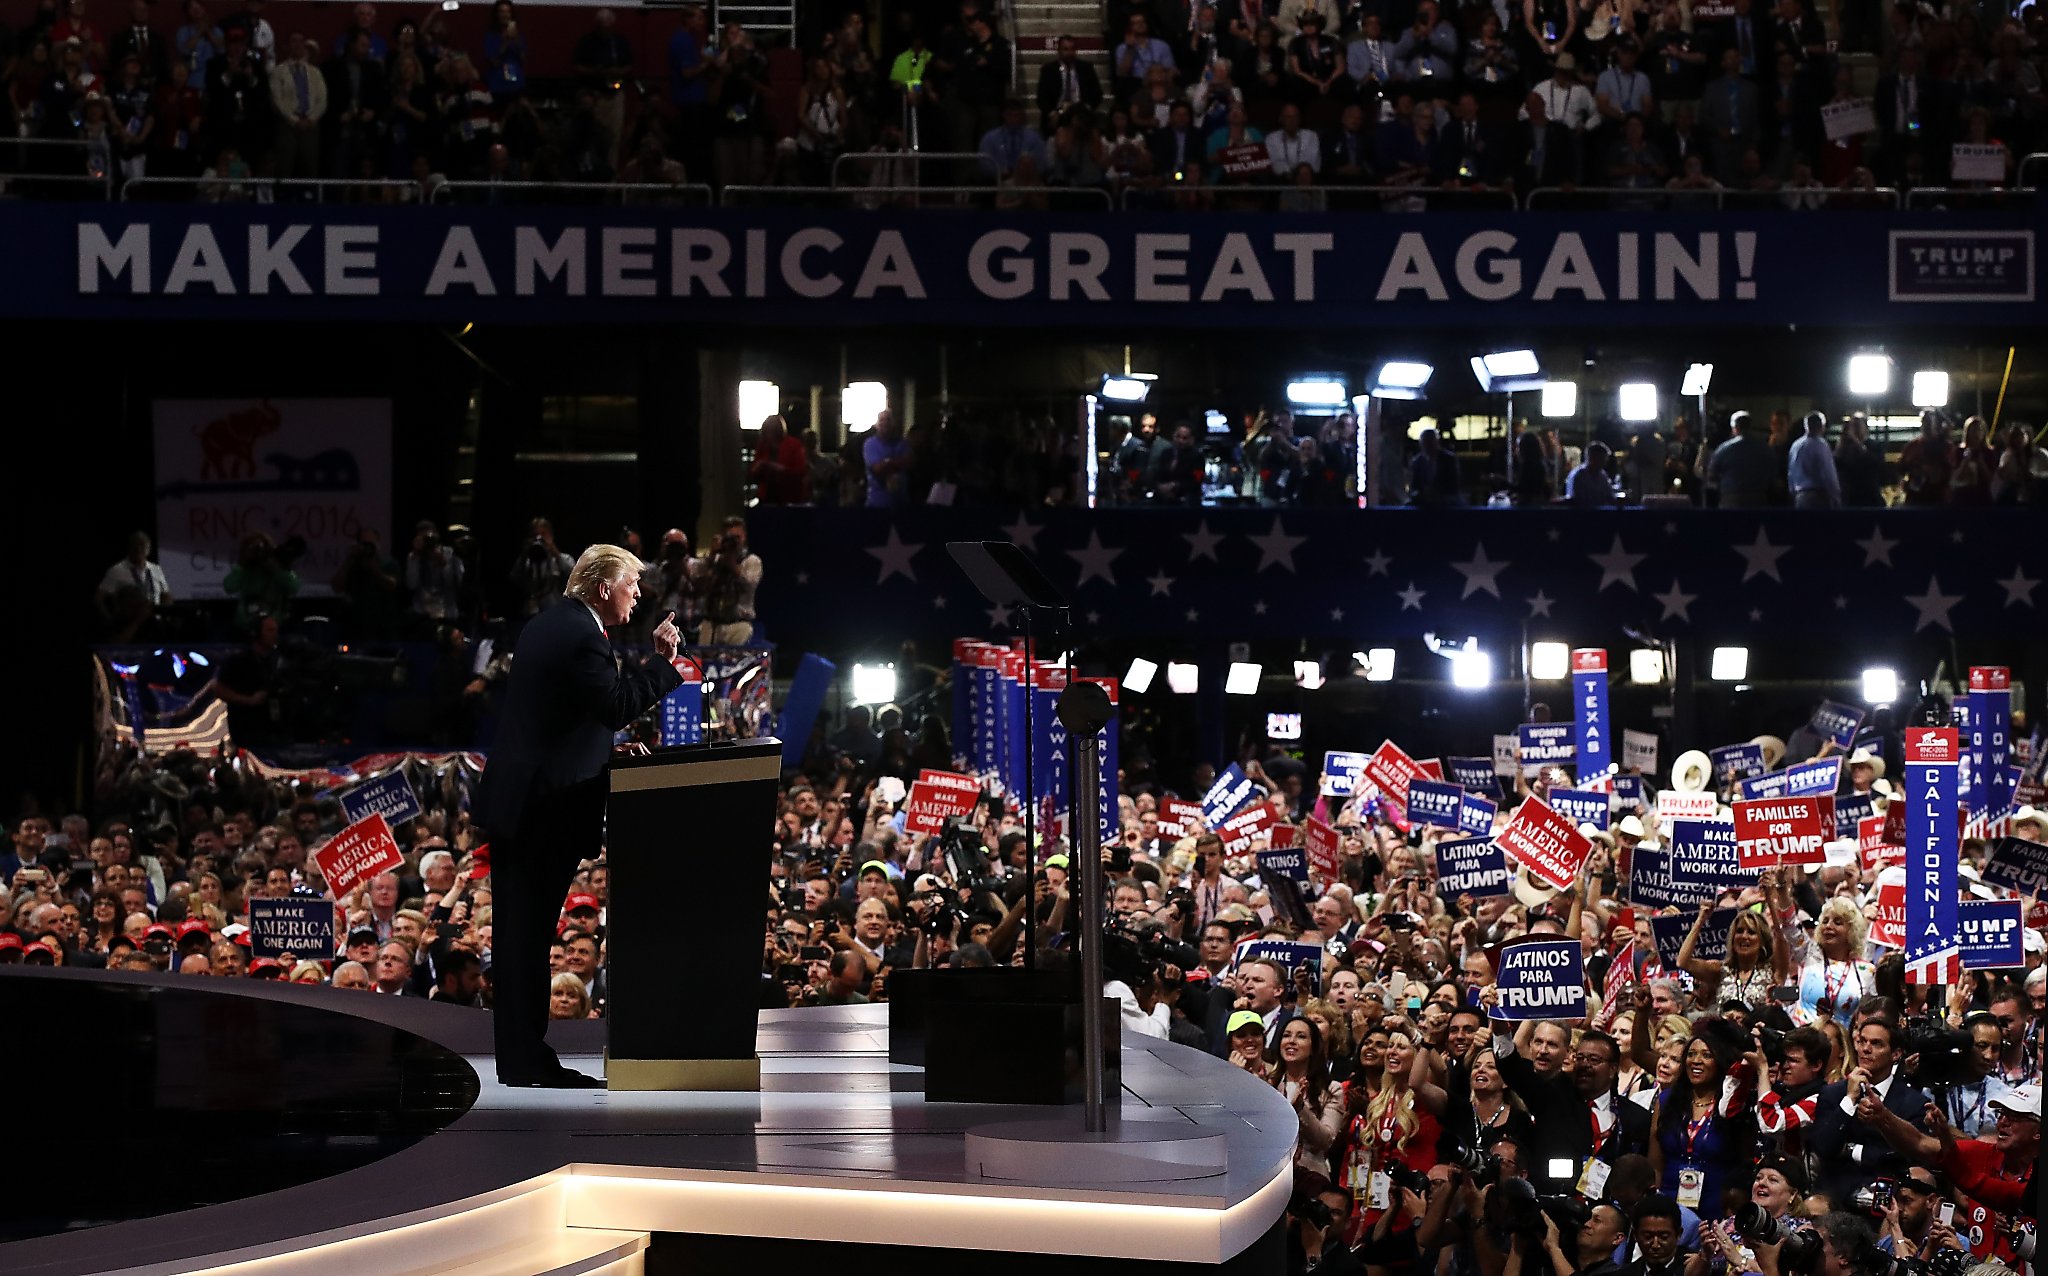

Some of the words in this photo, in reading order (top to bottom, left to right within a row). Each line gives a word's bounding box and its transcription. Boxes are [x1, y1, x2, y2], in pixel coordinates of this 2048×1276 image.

[79, 223, 380, 294] MAKE
[427, 227, 928, 300] AMERICA
[967, 229, 1334, 302] GREAT
[1376, 231, 1757, 301] AGAIN!
[1909, 247, 2015, 263] TRUMP
[1918, 264, 2005, 276] PENCE
[985, 670, 996, 764] DELAWARE
[1584, 680, 1600, 754] TEXAS
[1529, 727, 1568, 739] WOMEN
[1972, 711, 1983, 786] IOWA
[1991, 711, 2005, 786] IOWA
[1097, 724, 1109, 829] ARYLAND
[1409, 789, 1460, 806] TRUMP
[1551, 798, 1608, 813] TRUMP
[1661, 798, 1715, 809] TRUMP
[1223, 807, 1267, 832] WOMEN
[1745, 804, 1810, 822] FAMILIES
[1836, 804, 1870, 820] UMP
[1543, 818, 1571, 843] MAKE
[1703, 829, 1736, 843] MAKE
[1768, 822, 1792, 836] FOR
[336, 832, 361, 853] MAKE
[1442, 842, 1495, 862] LATINOS
[1511, 815, 1581, 878] AMERICA
[1673, 842, 1738, 862] AMERI
[1738, 834, 1823, 858] TRUMP
[1924, 768, 1941, 936] CALIFORNIA
[326, 832, 392, 882] AMERICA
[1454, 858, 1481, 872] PARA
[1508, 830, 1538, 860] WORK
[1535, 853, 1572, 881] AGAIN
[338, 867, 357, 887] ONE
[355, 849, 388, 874] AGAIN
[1680, 861, 1717, 875] WORK
[1440, 868, 1507, 892] TRUMP
[1637, 885, 1670, 902] WORK
[275, 907, 305, 918] MAKE
[252, 919, 332, 937] AMERICA
[1957, 918, 2018, 935] UMP
[263, 936, 285, 949] ONE
[285, 937, 323, 950] AGAIN
[1259, 949, 1292, 962] MAKE
[1505, 949, 1571, 970] LATINOS
[1519, 969, 1553, 984] PARA
[1496, 985, 1585, 1008] TRUMP
